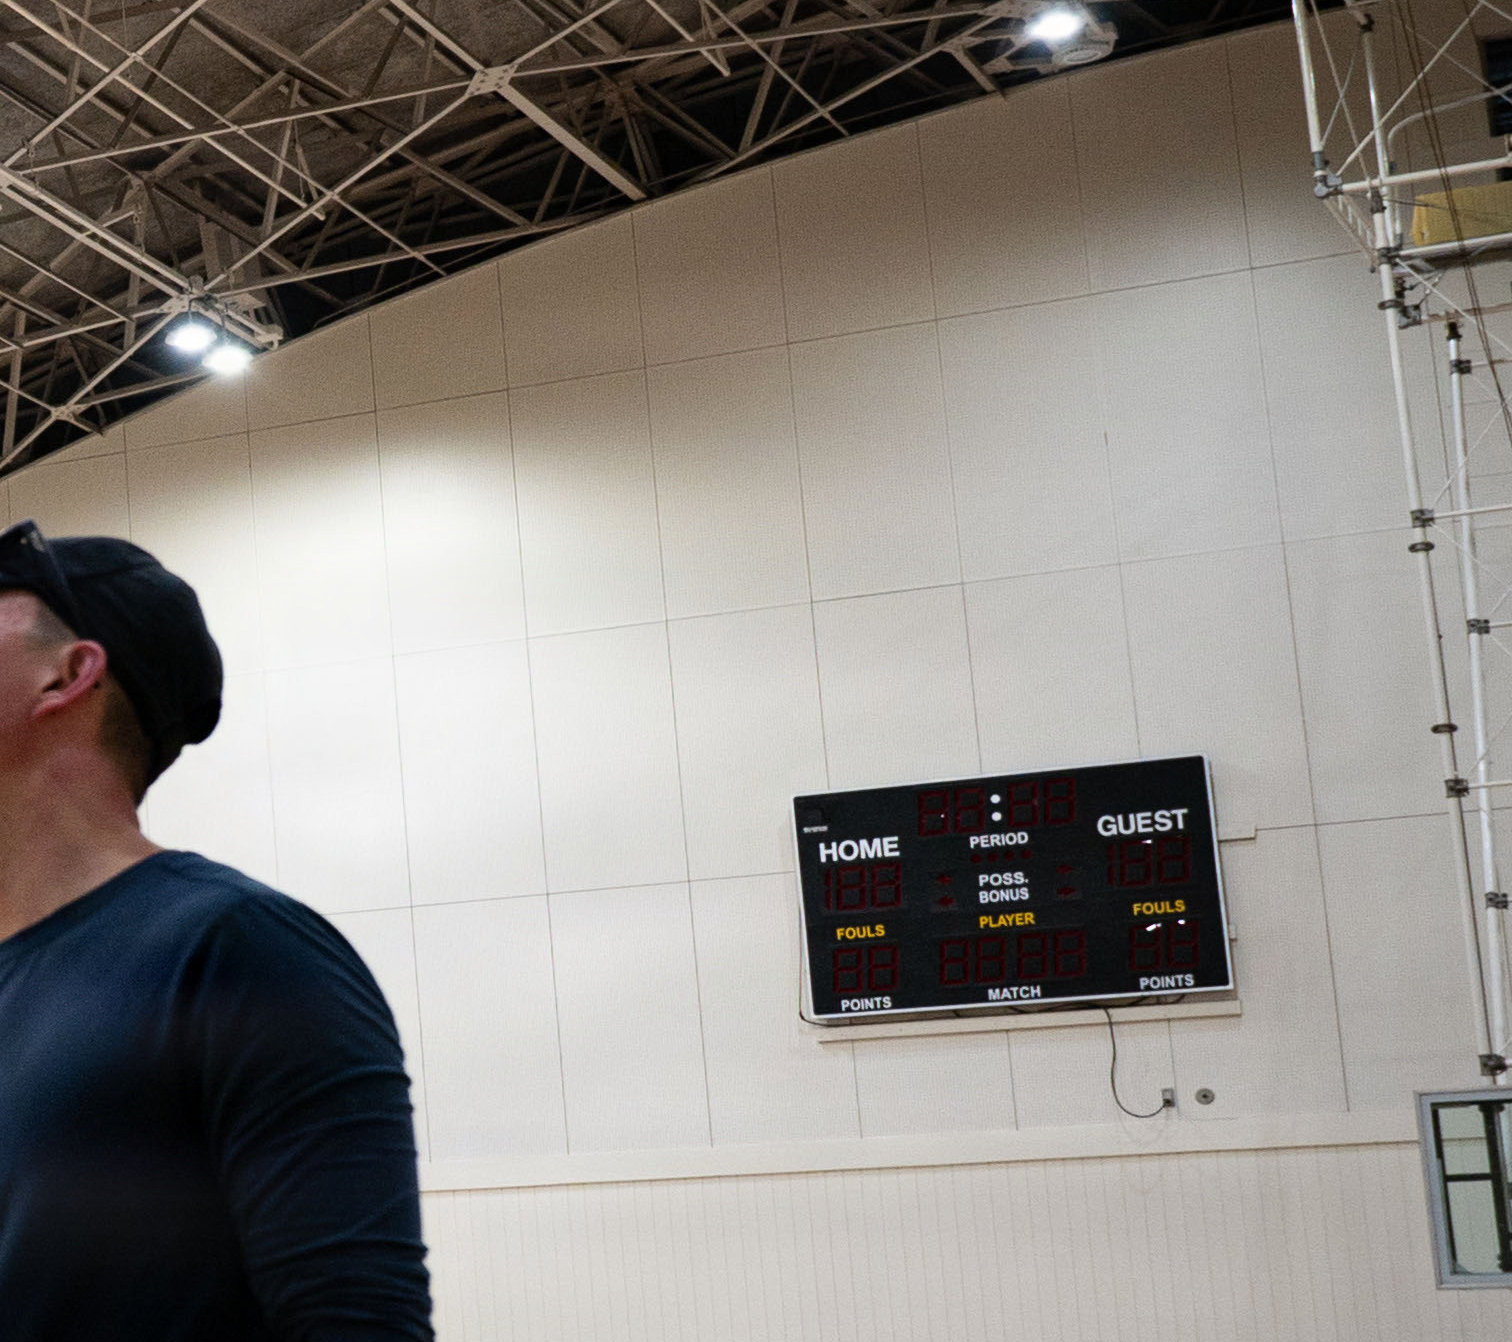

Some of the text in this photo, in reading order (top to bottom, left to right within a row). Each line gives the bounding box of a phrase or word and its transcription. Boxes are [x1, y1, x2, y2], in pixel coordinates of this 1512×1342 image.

[1096, 808, 1189, 837] GUEST
[969, 831, 1029, 849] PERIOD
[819, 836, 900, 863] HOME
[978, 871, 1029, 887] POSS.
[978, 887, 1030, 904] BONUS
[1132, 899, 1186, 916] FOULS
[979, 912, 1036, 929] PLAYER
[836, 924, 886, 941] FOULS
[1139, 974, 1195, 990] POINTS
[988, 986, 1041, 1001] MATCH
[840, 996, 892, 1011] POINTS
